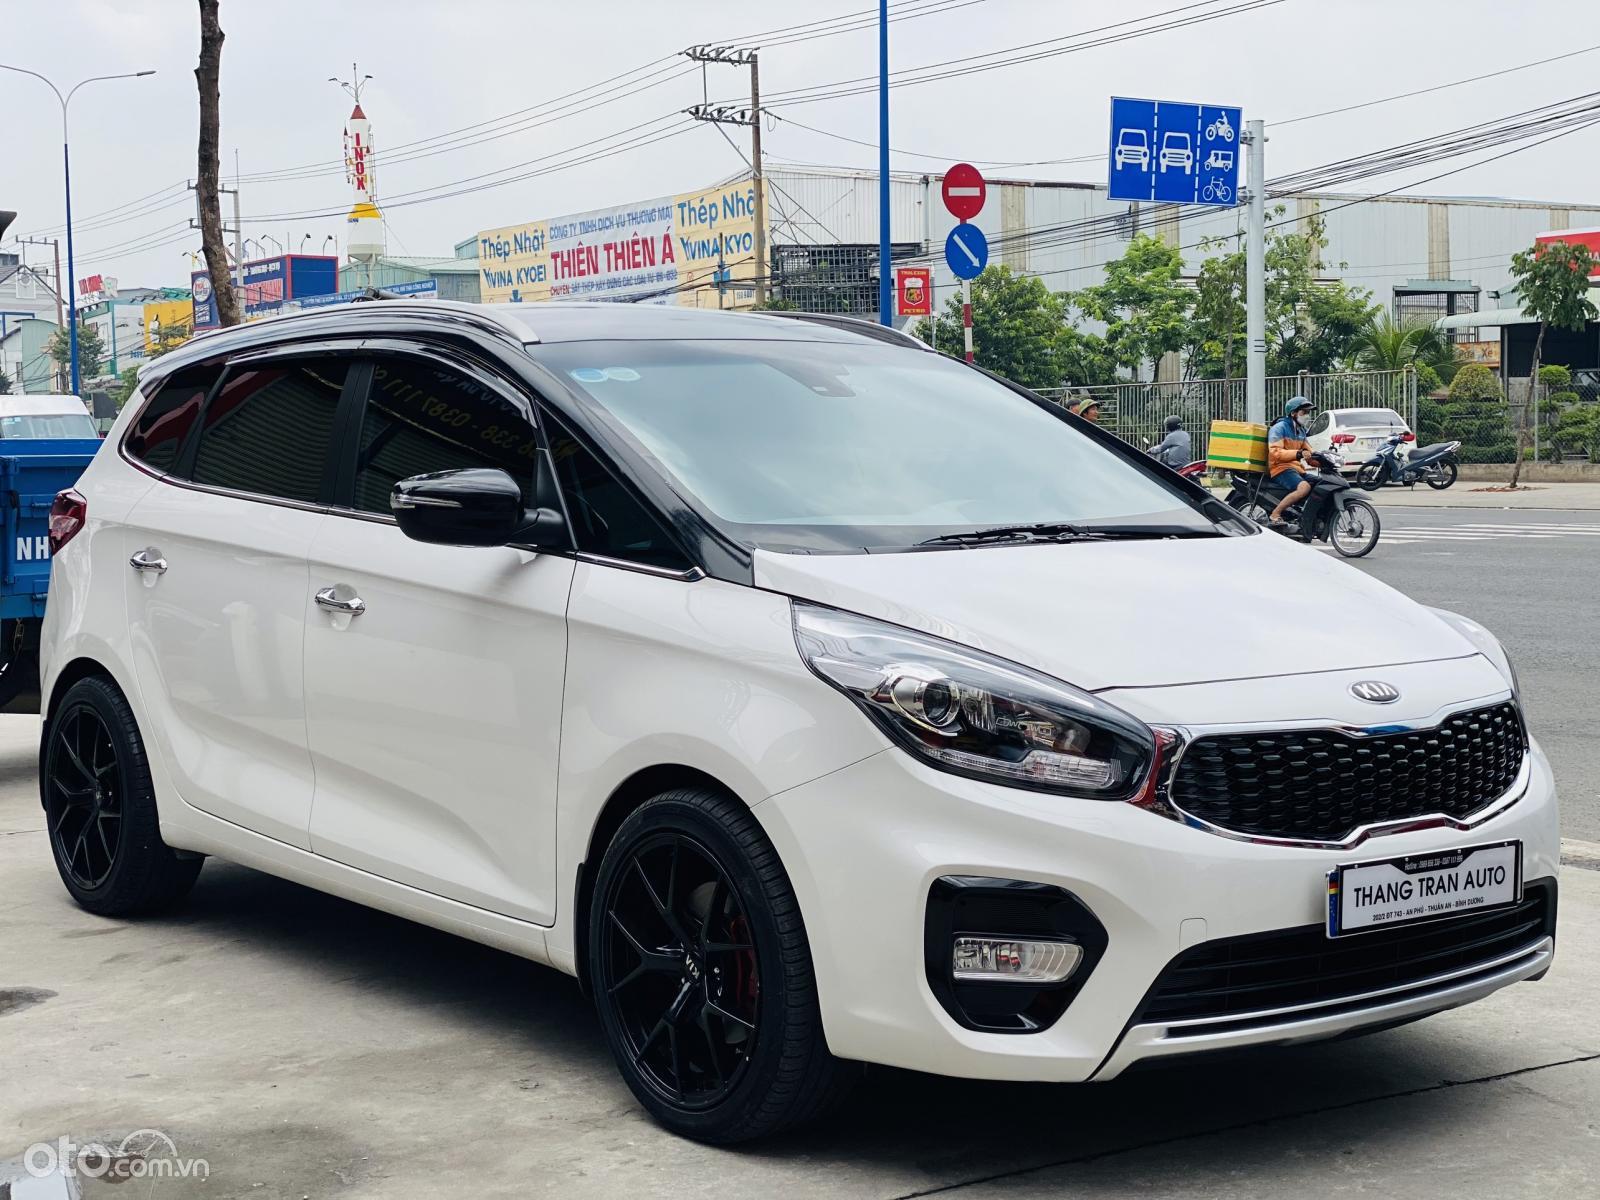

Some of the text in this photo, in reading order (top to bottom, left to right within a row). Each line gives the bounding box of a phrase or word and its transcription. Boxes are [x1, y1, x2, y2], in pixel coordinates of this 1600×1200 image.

[677, 189, 755, 229] Thép Nhậ
[549, 223, 568, 239] CÔNG
[569, 222, 577, 237] TY
[578, 219, 597, 234] TNHH
[481, 229, 545, 263] Thép Nhật
[551, 225, 675, 280] THIÊN THIÊN Á
[724, 232, 756, 255] KYO
[516, 264, 546, 285] KYOEI
[16, 535, 50, 561] NH
[1353, 865, 1506, 908] THANG TRAN AUTO
[1406, 908, 1413, 916] AN
[1444, 901, 1452, 910] AN
